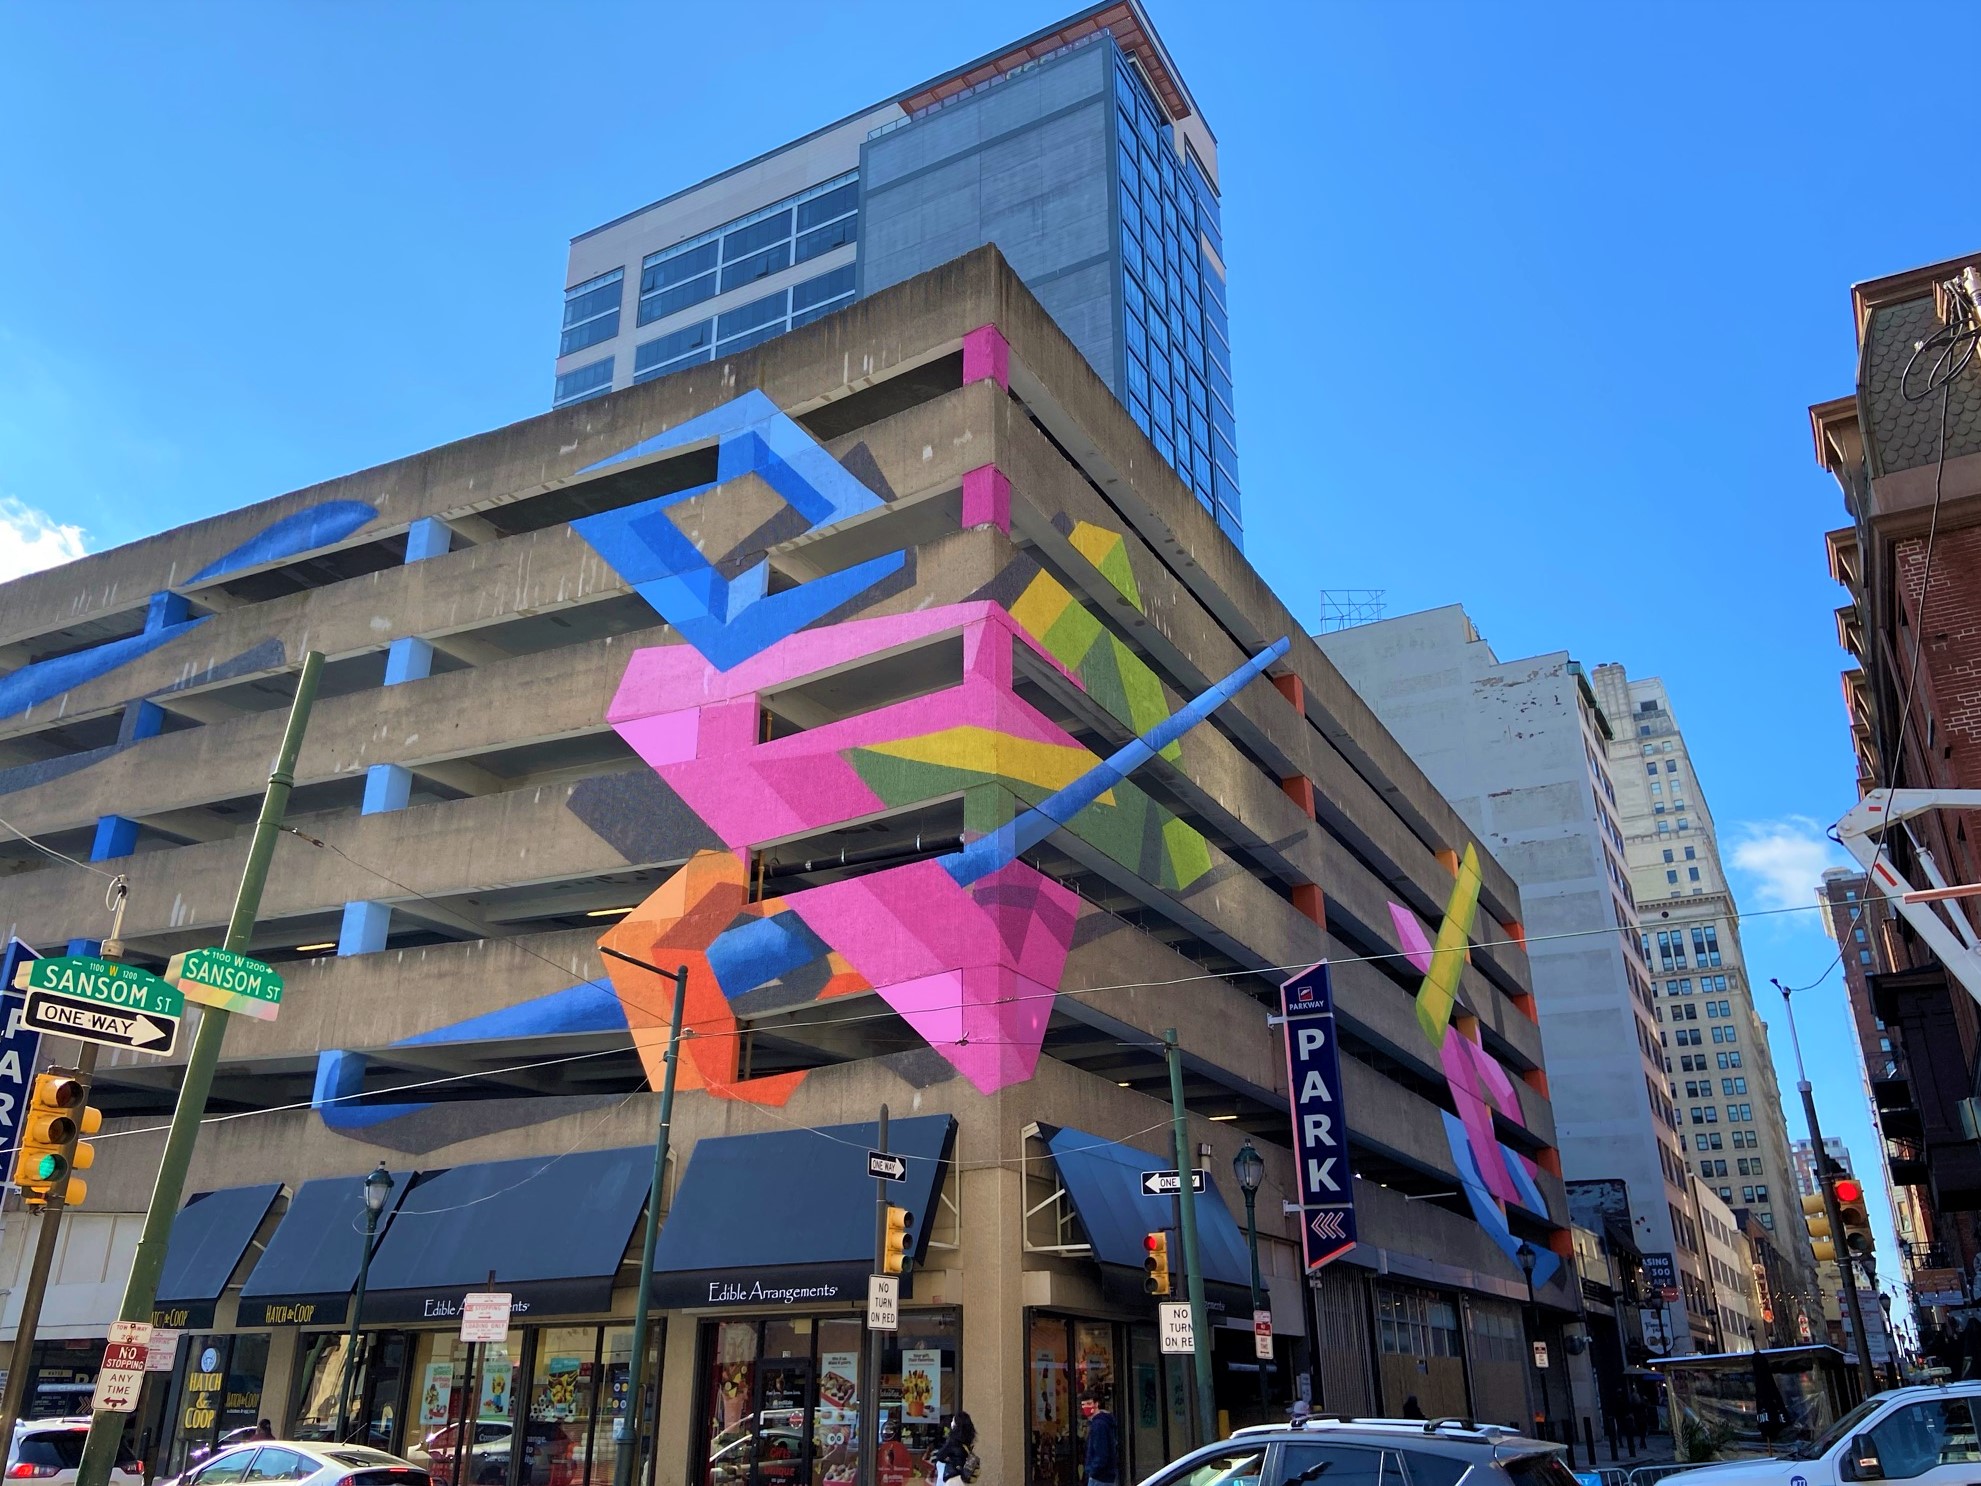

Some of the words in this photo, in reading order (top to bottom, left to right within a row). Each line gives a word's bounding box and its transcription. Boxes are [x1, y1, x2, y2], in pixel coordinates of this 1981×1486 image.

[213, 952, 231, 962] 1100
[234, 955, 244, 968] W
[246, 961, 265, 972] 1200
[90, 962, 104, 973] 1100
[109, 965, 118, 977] W
[123, 970, 137, 981] 1200
[186, 958, 261, 995] SANSOM
[266, 986, 280, 1000] ST
[43, 965, 148, 1008] SANSOM
[155, 996, 172, 1013] ST
[1289, 1000, 1324, 1010] PARKWAY
[45, 1005, 85, 1025] ONE
[91, 1015, 134, 1034] WAY
[1298, 1028, 1341, 1193] PARK
[873, 1160, 883, 1170] ONE
[884, 1162, 896, 1172] WAY
[1160, 1178, 1177, 1187] ONE
[1642, 1258, 1669, 1266] ASING
[708, 1282, 747, 1301] Edible
[749, 1281, 837, 1304] Arrangements
[878, 1281, 889, 1293] NO
[424, 1299, 456, 1317] Edible
[875, 1297, 892, 1308] TURN
[266, 1305, 287, 1323] HATCH
[294, 1303, 315, 1323] COOP
[871, 1312, 880, 1322] ON
[882, 1312, 895, 1324] RED
[1173, 1309, 1188, 1318] NO
[1165, 1338, 1178, 1346] ON
[1181, 1337, 1194, 1347] RE
[119, 1346, 137, 1359] NO
[106, 1358, 144, 1370] STOPPING
[110, 1374, 134, 1383] ANY
[189, 1372, 222, 1391] HATCH
[107, 1385, 131, 1395] TIME
[196, 1392, 208, 1409] &
[185, 1407, 215, 1429] COOP
